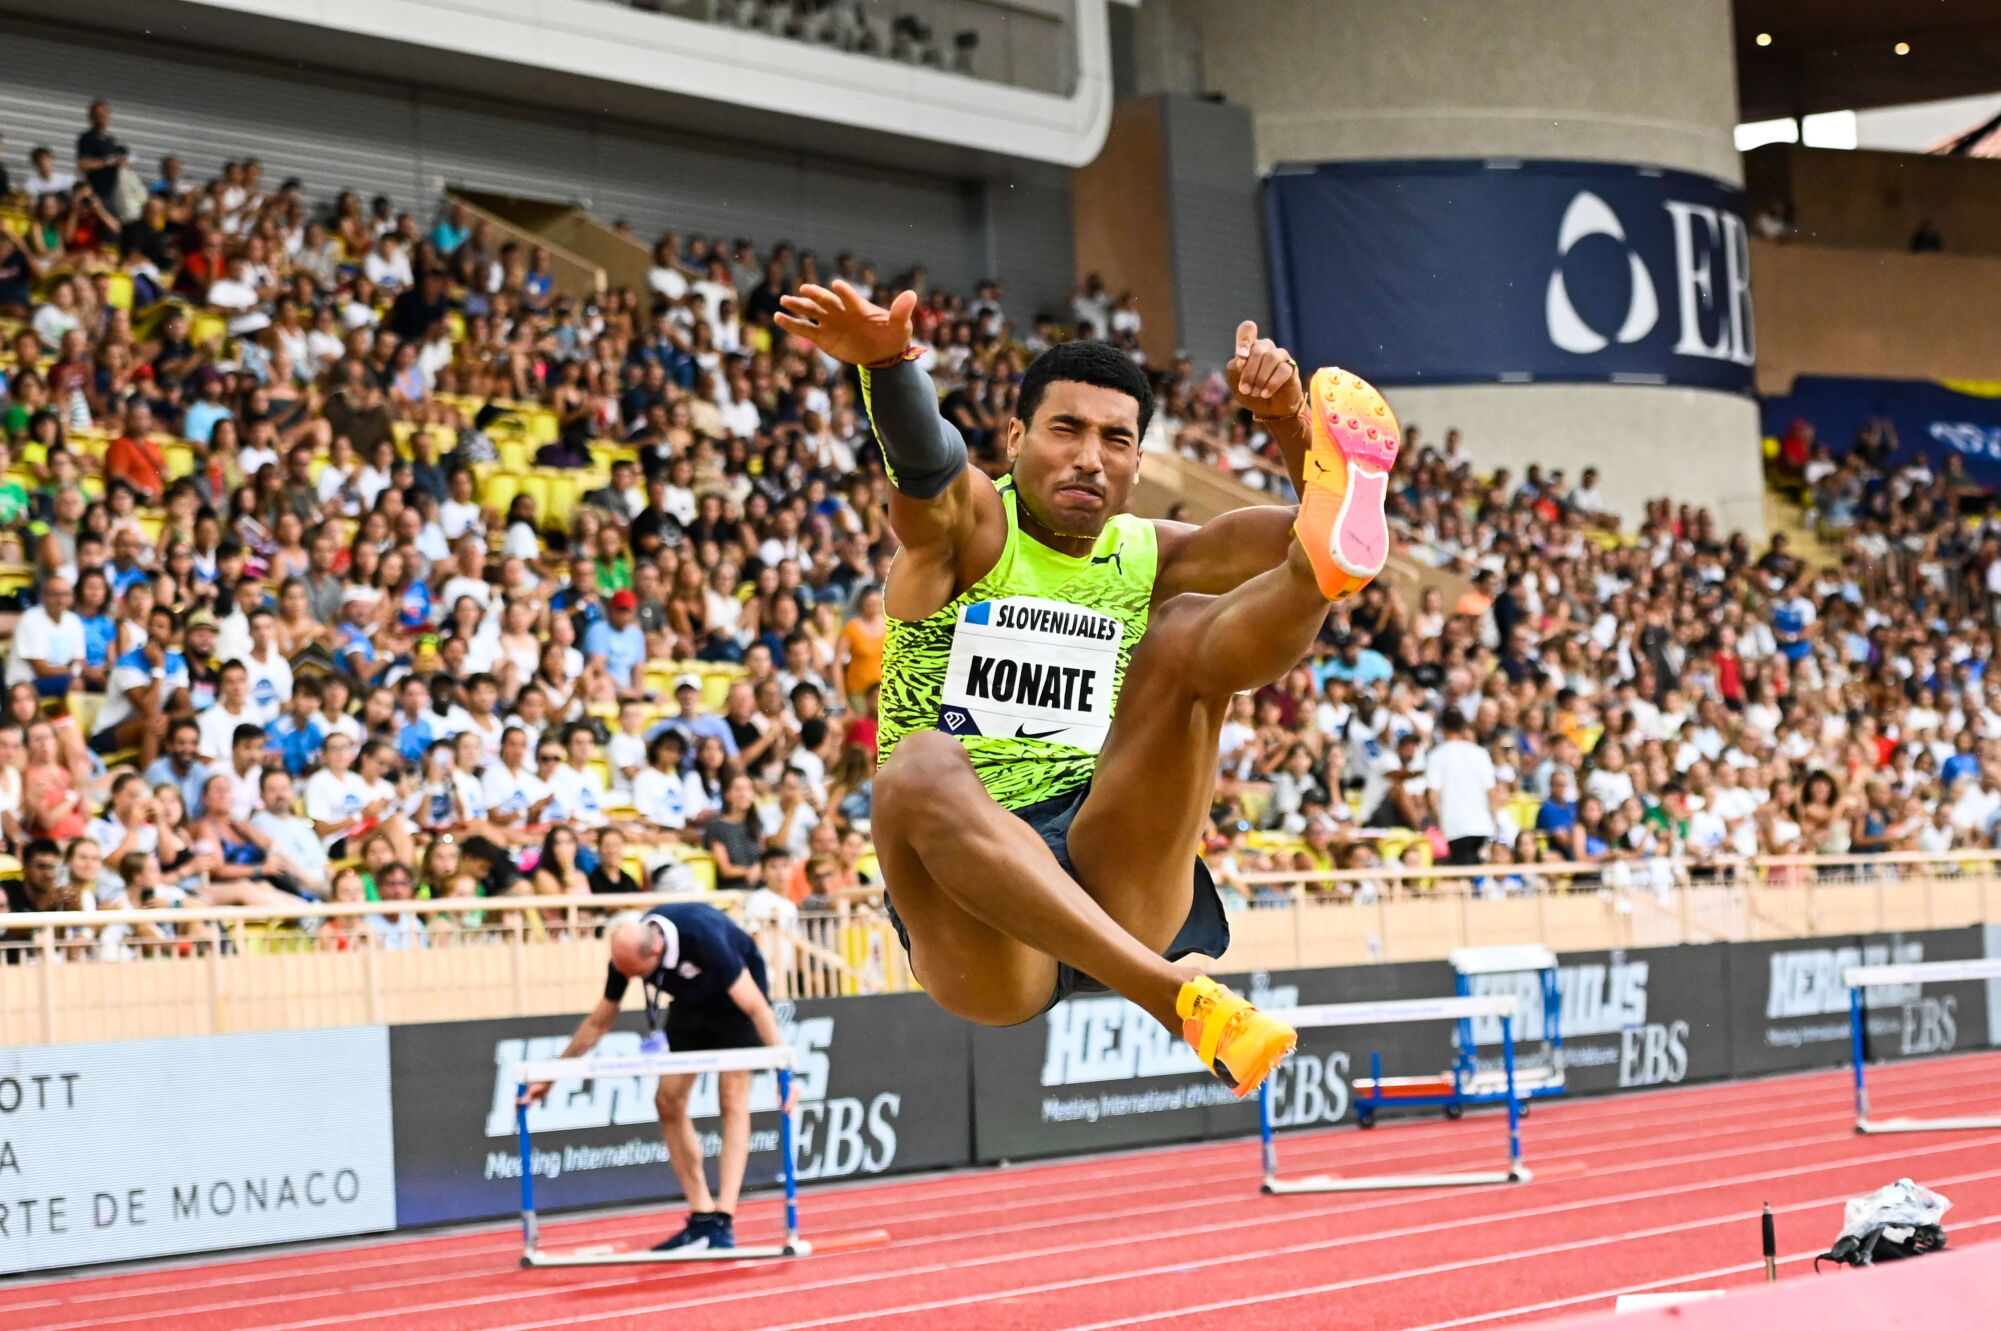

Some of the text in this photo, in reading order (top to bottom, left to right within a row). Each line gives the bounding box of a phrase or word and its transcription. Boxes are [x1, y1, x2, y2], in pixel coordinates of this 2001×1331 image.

[996, 604, 1117, 641] SLOVENIJALES
[965, 655, 1097, 713] KONATE
[1618, 1019, 1690, 1088] EBS
[1902, 995, 1958, 1056] EBS
[1264, 1050, 1349, 1128] EBS
[776, 1092, 901, 1182] EBS
[94, 1190, 147, 1228] DE
[173, 1169, 360, 1220] MONACO
